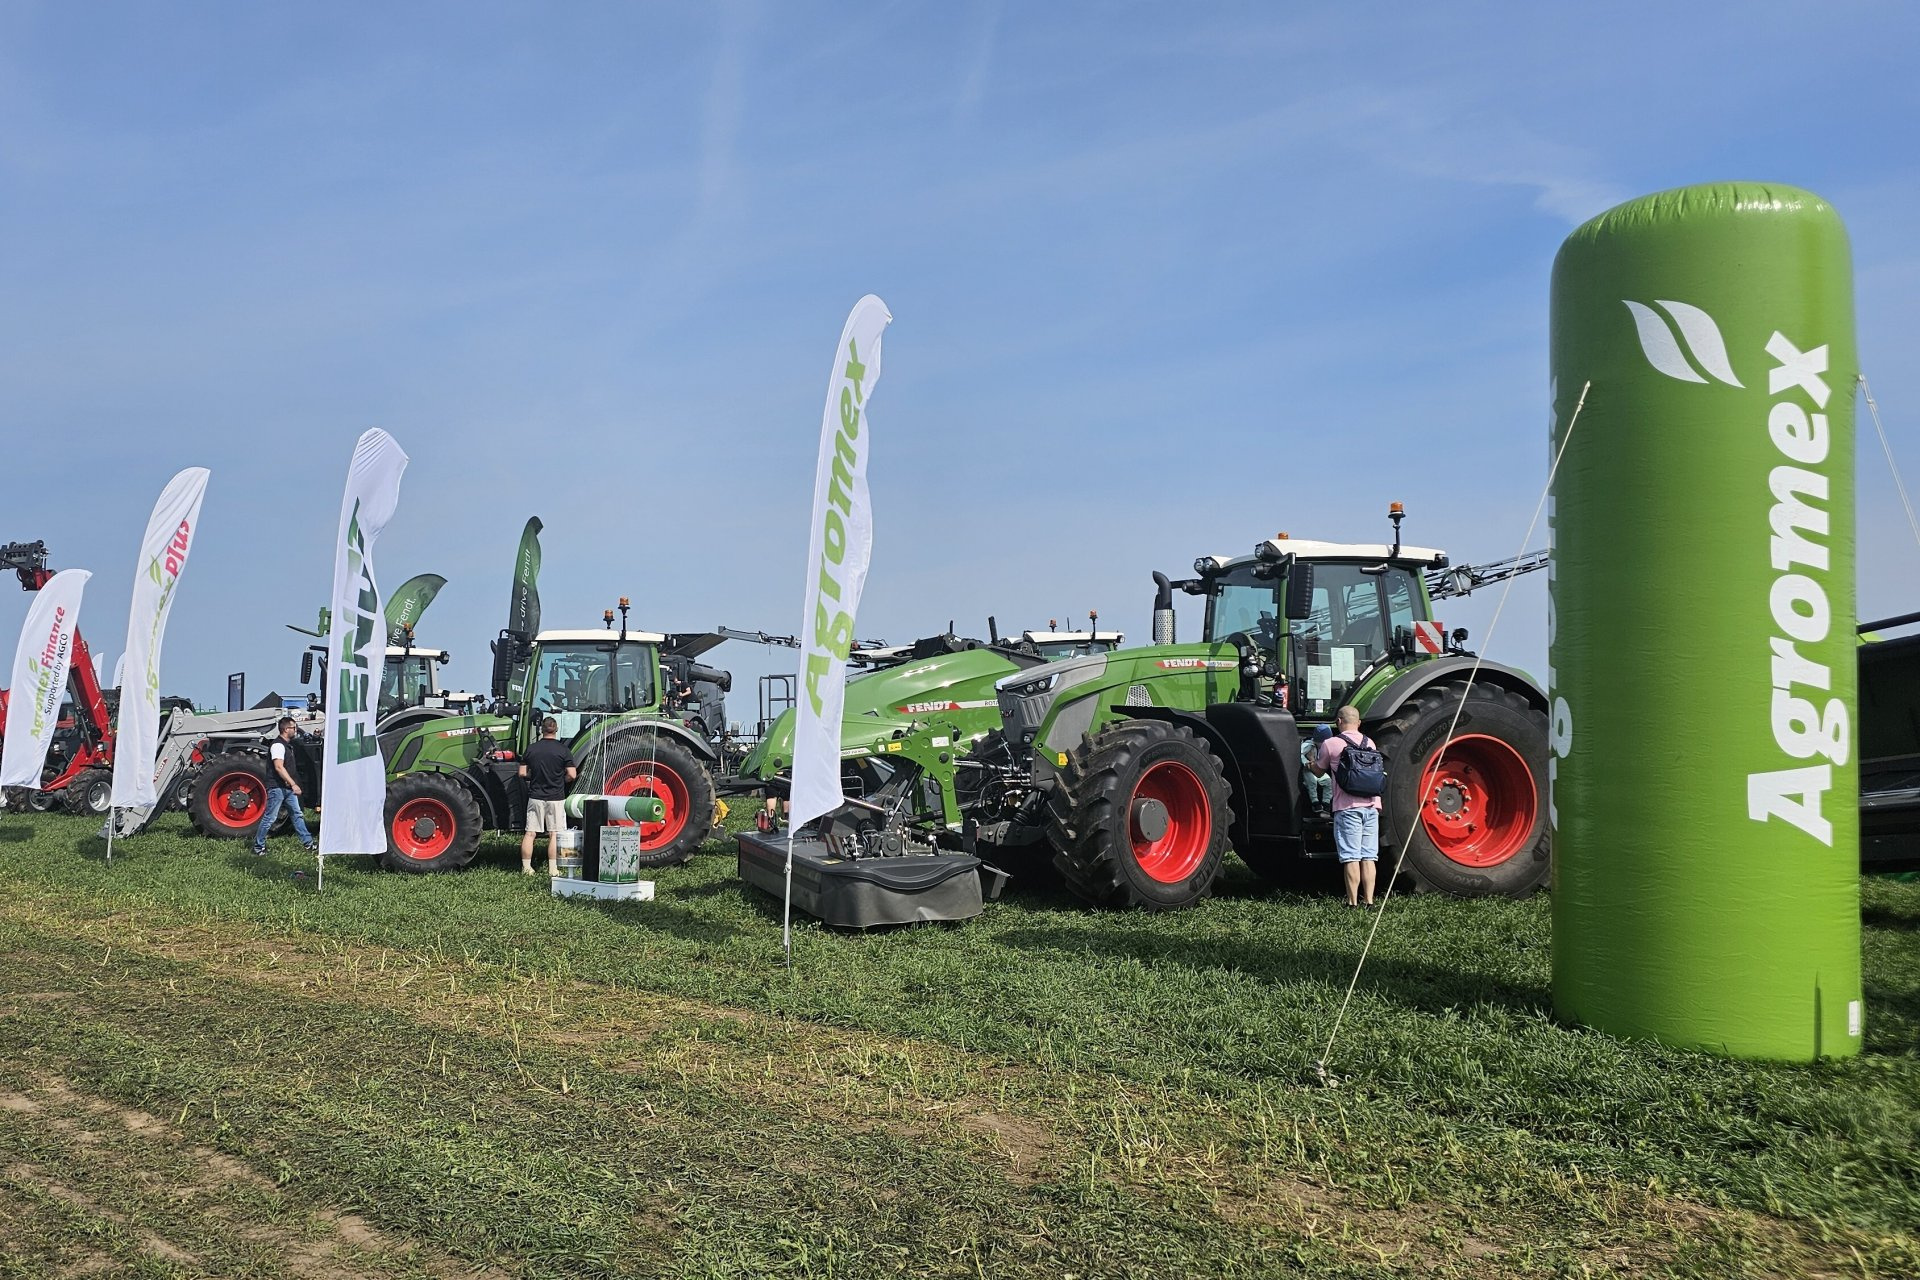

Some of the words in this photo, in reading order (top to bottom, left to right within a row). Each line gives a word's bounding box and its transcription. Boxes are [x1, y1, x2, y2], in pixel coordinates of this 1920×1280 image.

[806, 338, 867, 718] Agromex
[519, 587, 529, 619] drive
[1748, 330, 1848, 848] Agromex
[41, 606, 66, 670] Finance
[337, 496, 378, 764] FENDT
[387, 628, 403, 647] rive
[58, 633, 69, 660] AGCO
[55, 658, 64, 668] by
[1163, 659, 1200, 668] FENDT
[44, 669, 61, 716] Supported
[907, 700, 953, 713] FENDT
